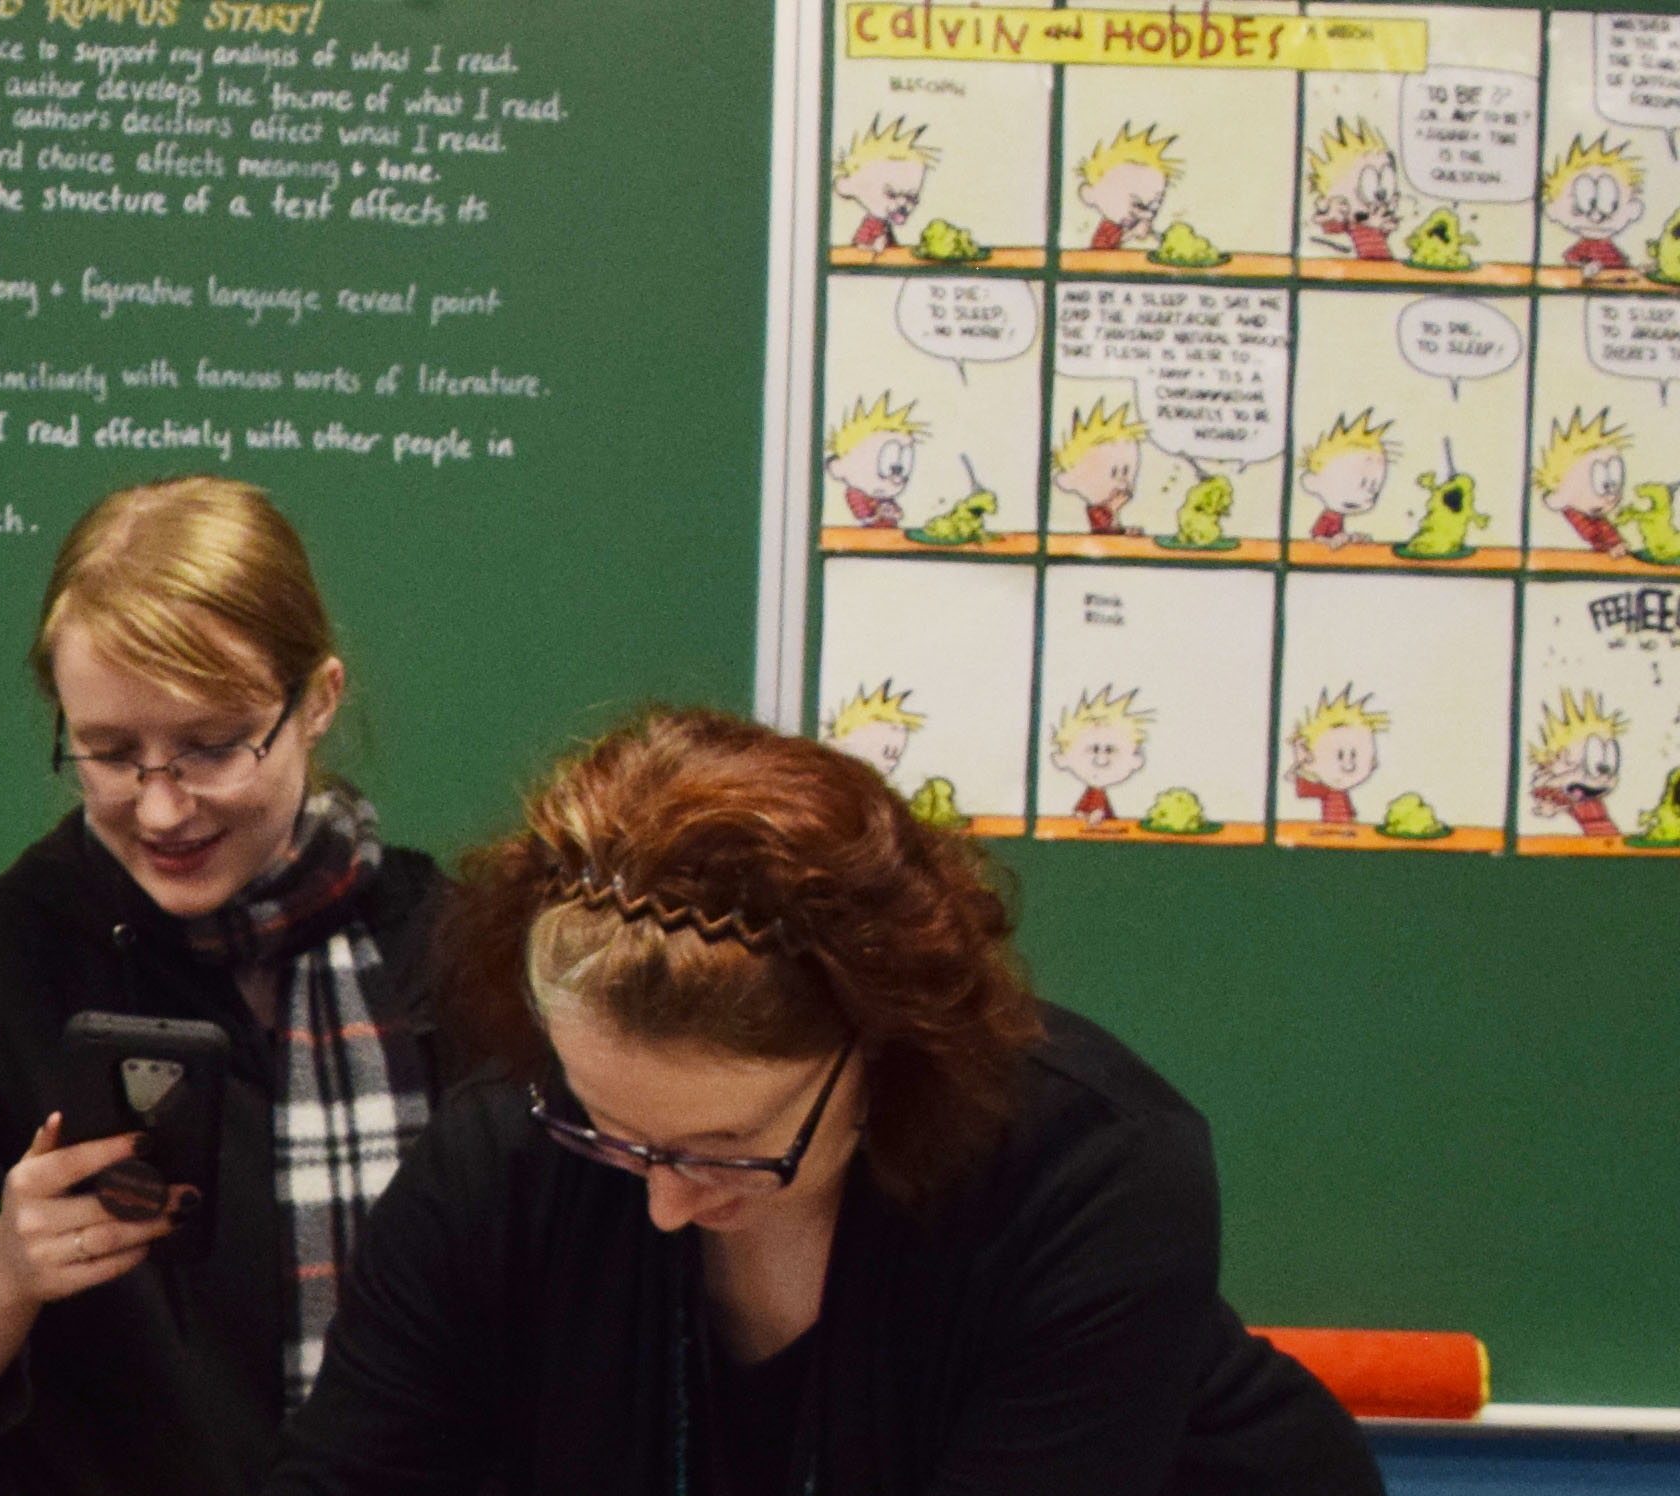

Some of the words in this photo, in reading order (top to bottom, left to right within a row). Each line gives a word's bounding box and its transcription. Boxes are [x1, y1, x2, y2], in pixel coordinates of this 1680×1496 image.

[203, 0, 325, 35] START!
[1044, 15, 1083, 39] and
[39, 35, 58, 59] to
[74, 38, 158, 76] support
[169, 47, 204, 82] my
[212, 41, 299, 82] analysis
[313, 38, 338, 68] of
[351, 41, 411, 72] what
[424, 45, 442, 74] I
[457, 42, 519, 74] read.
[42, 186, 168, 215] structure
[184, 185, 212, 215] of
[229, 196, 253, 217] a
[273, 185, 335, 221] text
[350, 188, 447, 226] affects
[457, 194, 488, 223] its
[81, 266, 194, 319] figurative
[208, 274, 322, 325] language
[338, 283, 417, 314] reveal
[430, 286, 502, 326] point
[122, 359, 179, 388] with
[196, 357, 283, 389] famous
[294, 366, 361, 394] works
[375, 364, 403, 395] of
[418, 363, 552, 397] literature.
[27, 414, 79, 447] read
[94, 417, 231, 462] effectively
[245, 419, 302, 450] with
[312, 421, 383, 454] other
[392, 427, 472, 467] people
[487, 428, 515, 458] in
